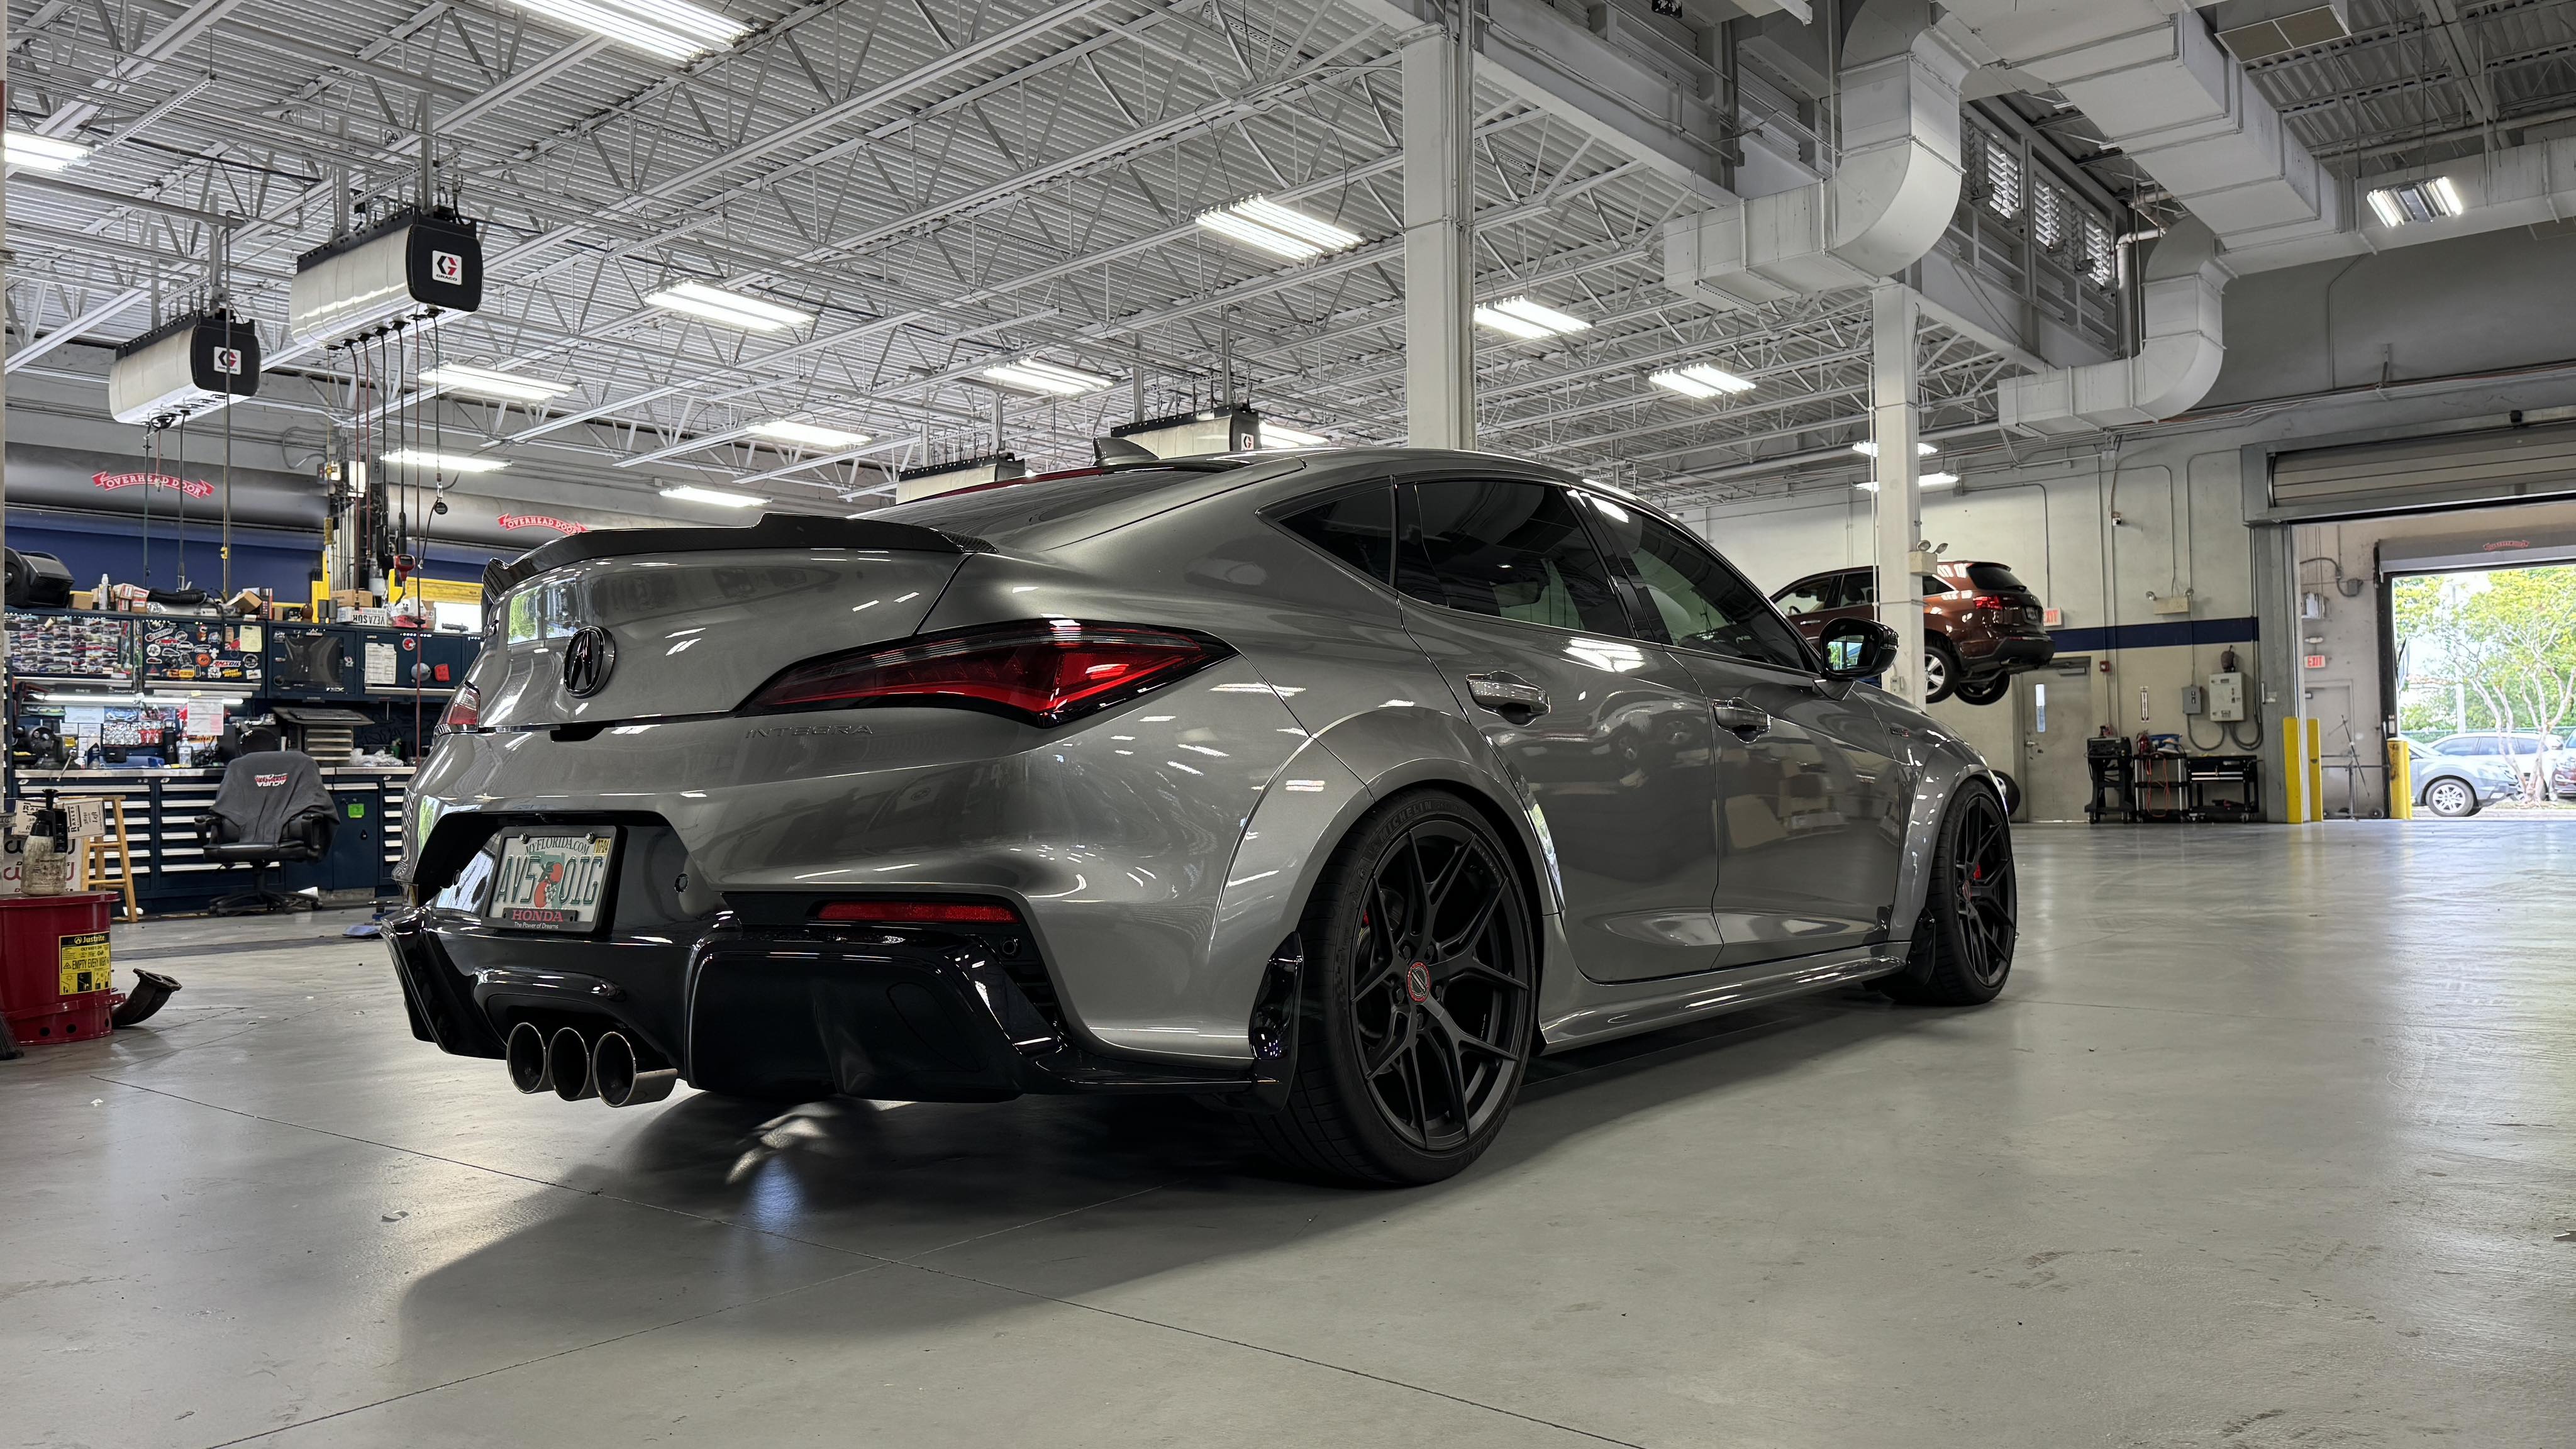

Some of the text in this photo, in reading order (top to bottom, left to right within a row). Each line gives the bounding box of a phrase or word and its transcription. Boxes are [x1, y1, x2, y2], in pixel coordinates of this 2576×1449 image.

[508, 518, 577, 534] OVERHEAD DOOR
[2045, 610, 2058, 623] XIT
[2307, 656, 2322, 667] EXIT
[745, 724, 872, 738] INTEGRA
[1379, 799, 1433, 843] MICHELIN
[526, 837, 590, 855] MYFLORIDA.COM
[511, 909, 564, 922] HONDA
[82, 935, 105, 943] Justrite
